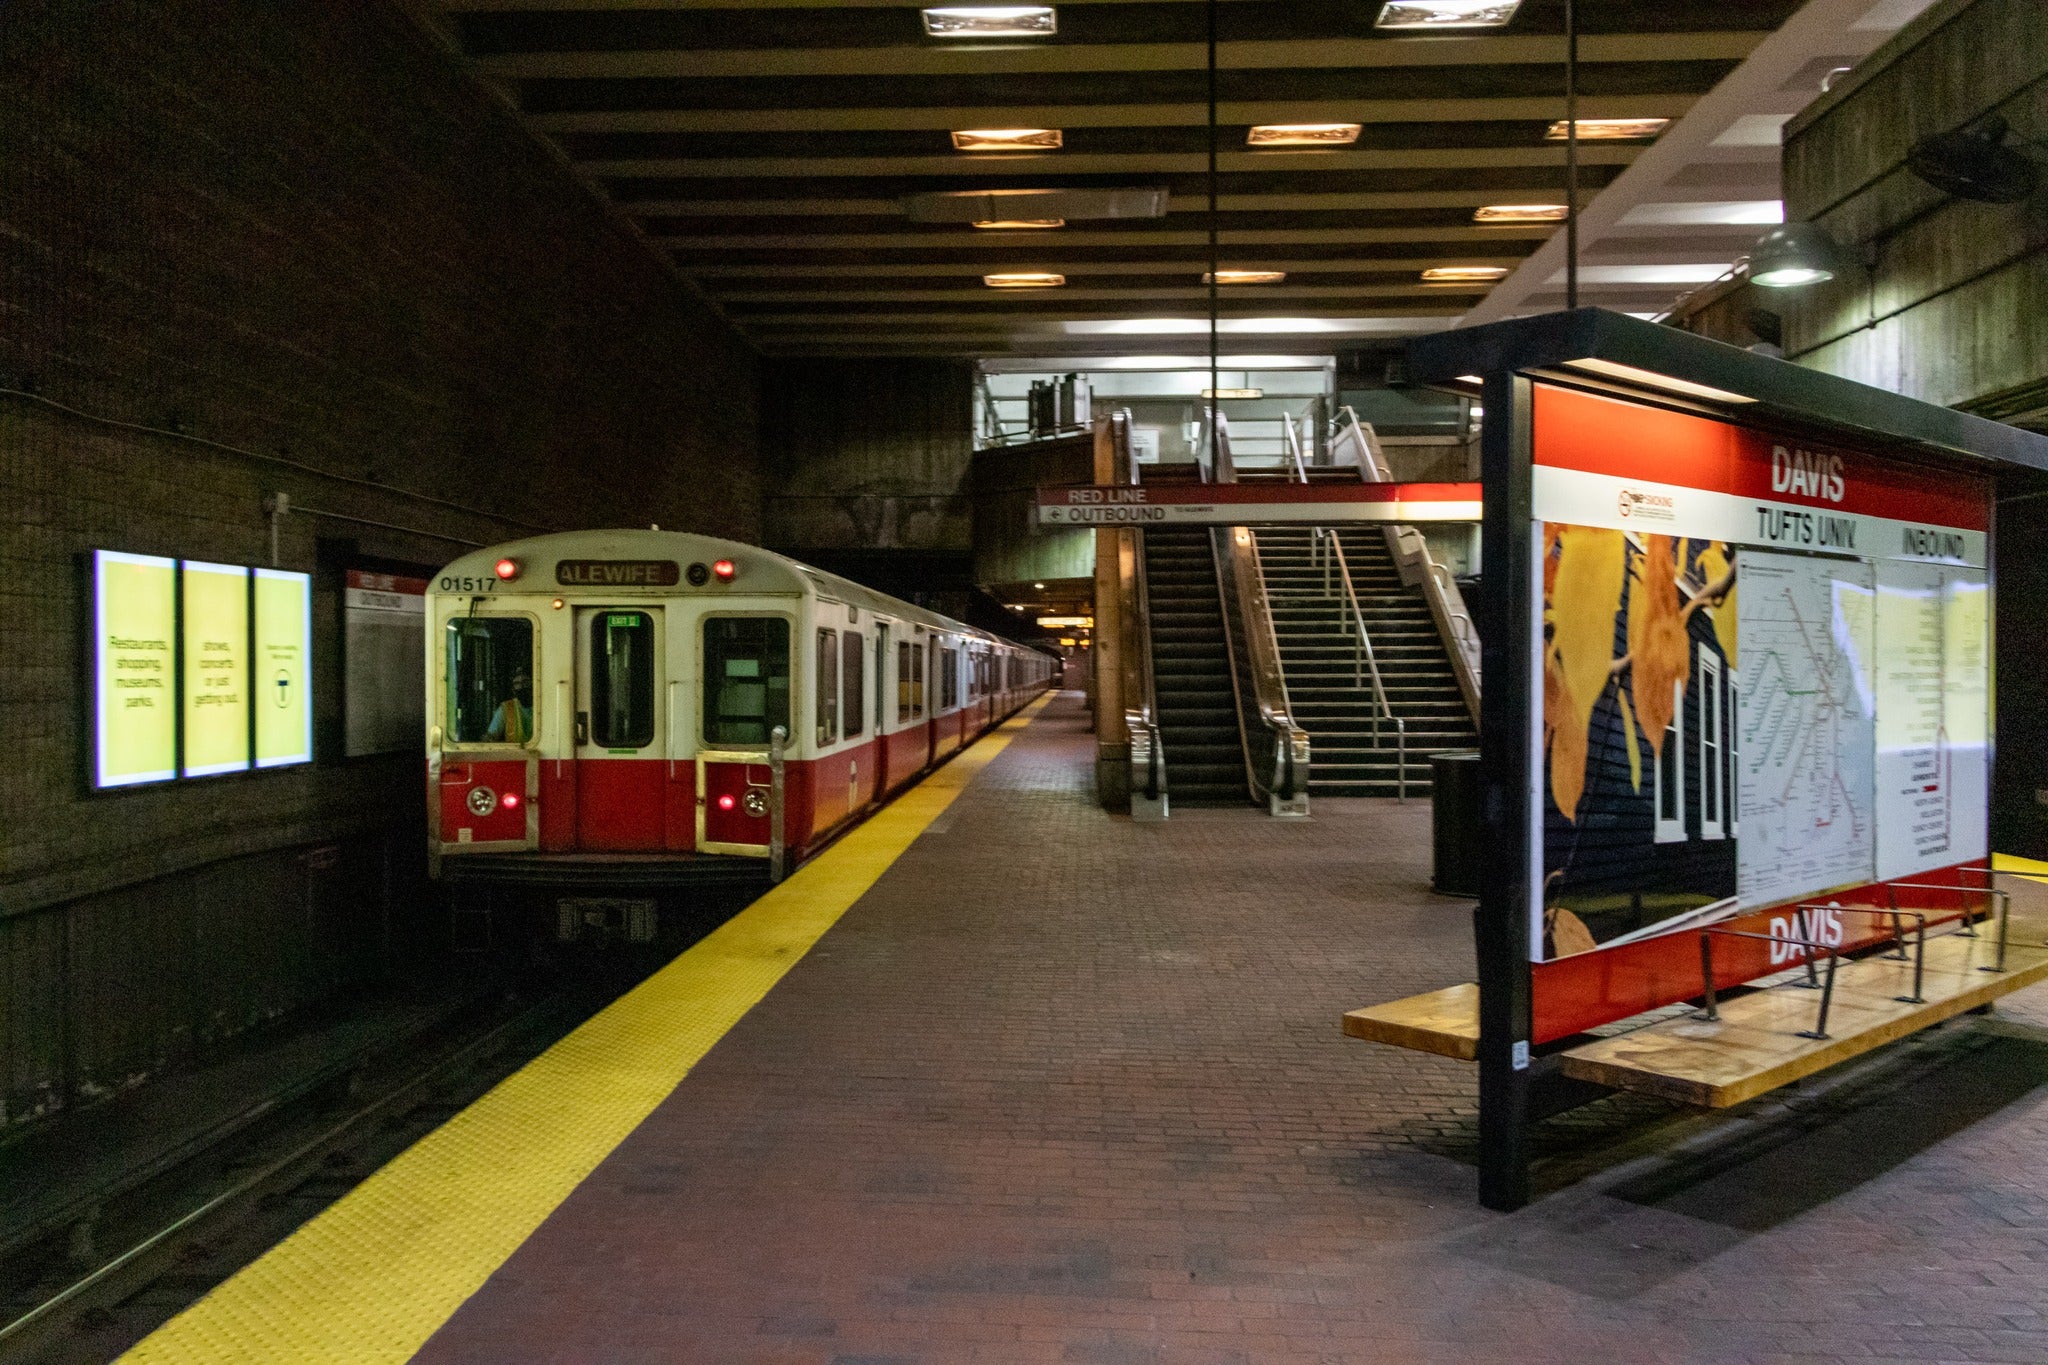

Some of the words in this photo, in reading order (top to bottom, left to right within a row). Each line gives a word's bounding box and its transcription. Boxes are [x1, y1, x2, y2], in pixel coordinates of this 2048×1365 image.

[1772, 445, 1845, 502] DAVIS
[1069, 489, 1104, 503] RED
[1108, 489, 1147, 503] LINE
[1069, 507, 1166, 522] OUTBOUND
[1757, 507, 1812, 544] TUFTS
[1902, 527, 1965, 560] INBOUND
[440, 577, 497, 591] 01517
[560, 565, 660, 583] ALEWIFE
[1770, 900, 1843, 965] DAVIS
